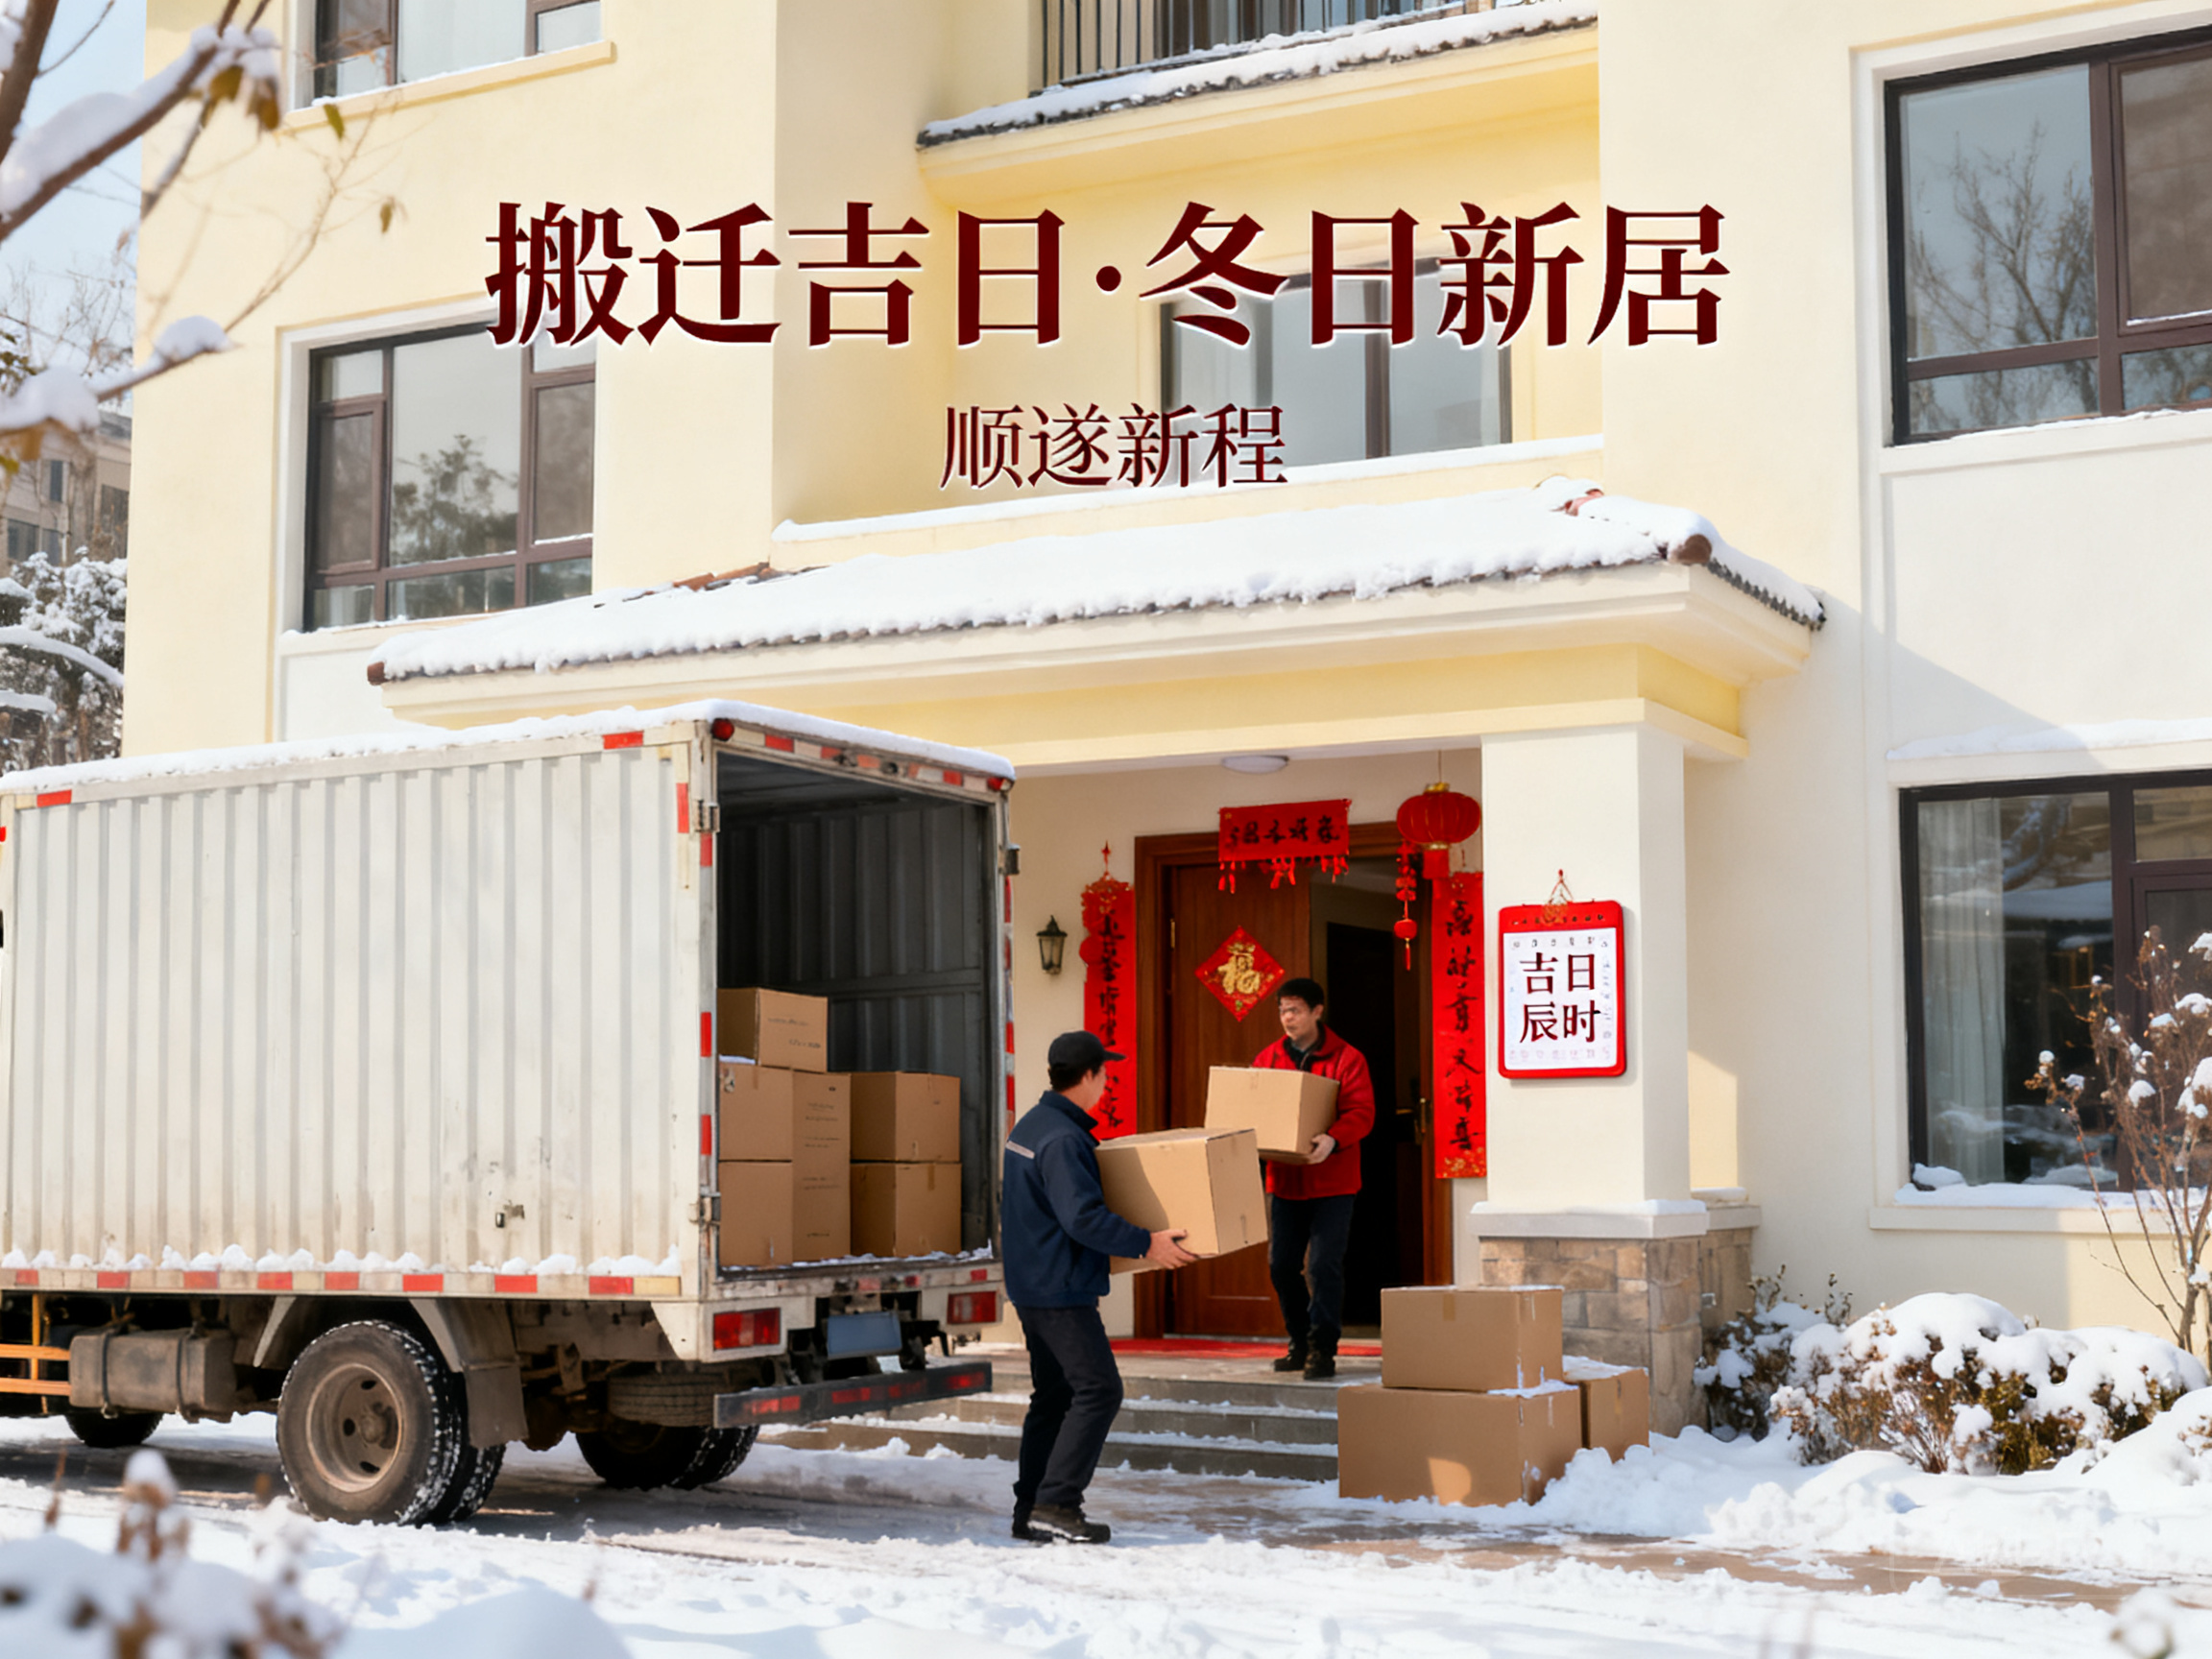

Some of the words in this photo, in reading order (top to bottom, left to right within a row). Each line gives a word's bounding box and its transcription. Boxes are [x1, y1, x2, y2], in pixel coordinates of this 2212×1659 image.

[1217, 942, 1261, 994] 福
[1520, 952, 1595, 994] 吉日
[1520, 1000, 1600, 1043] 辰时
